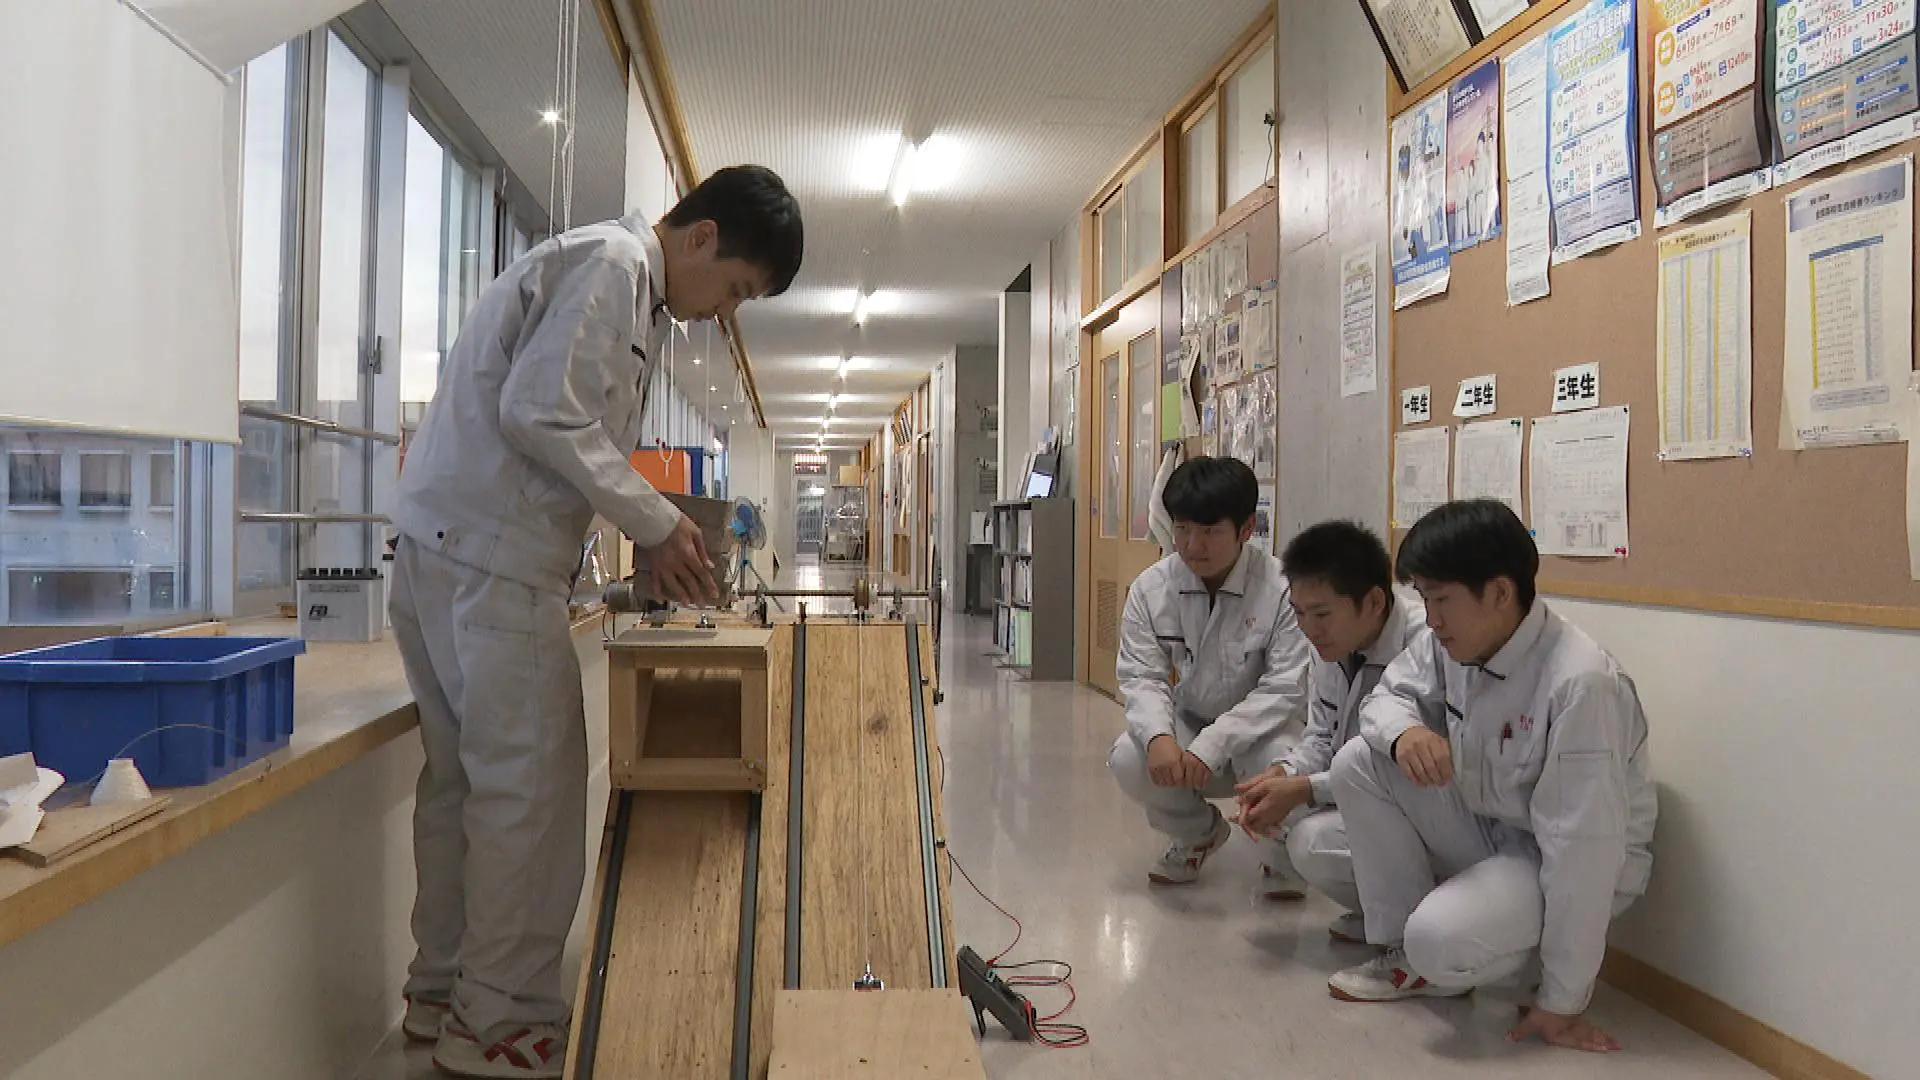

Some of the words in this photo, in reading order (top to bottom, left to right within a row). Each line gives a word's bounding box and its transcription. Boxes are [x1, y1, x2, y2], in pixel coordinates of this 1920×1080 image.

[1461, 383, 1493, 407] 二年生
[1558, 372, 1595, 400] 三年生
[1404, 394, 1428, 414] 一年生
